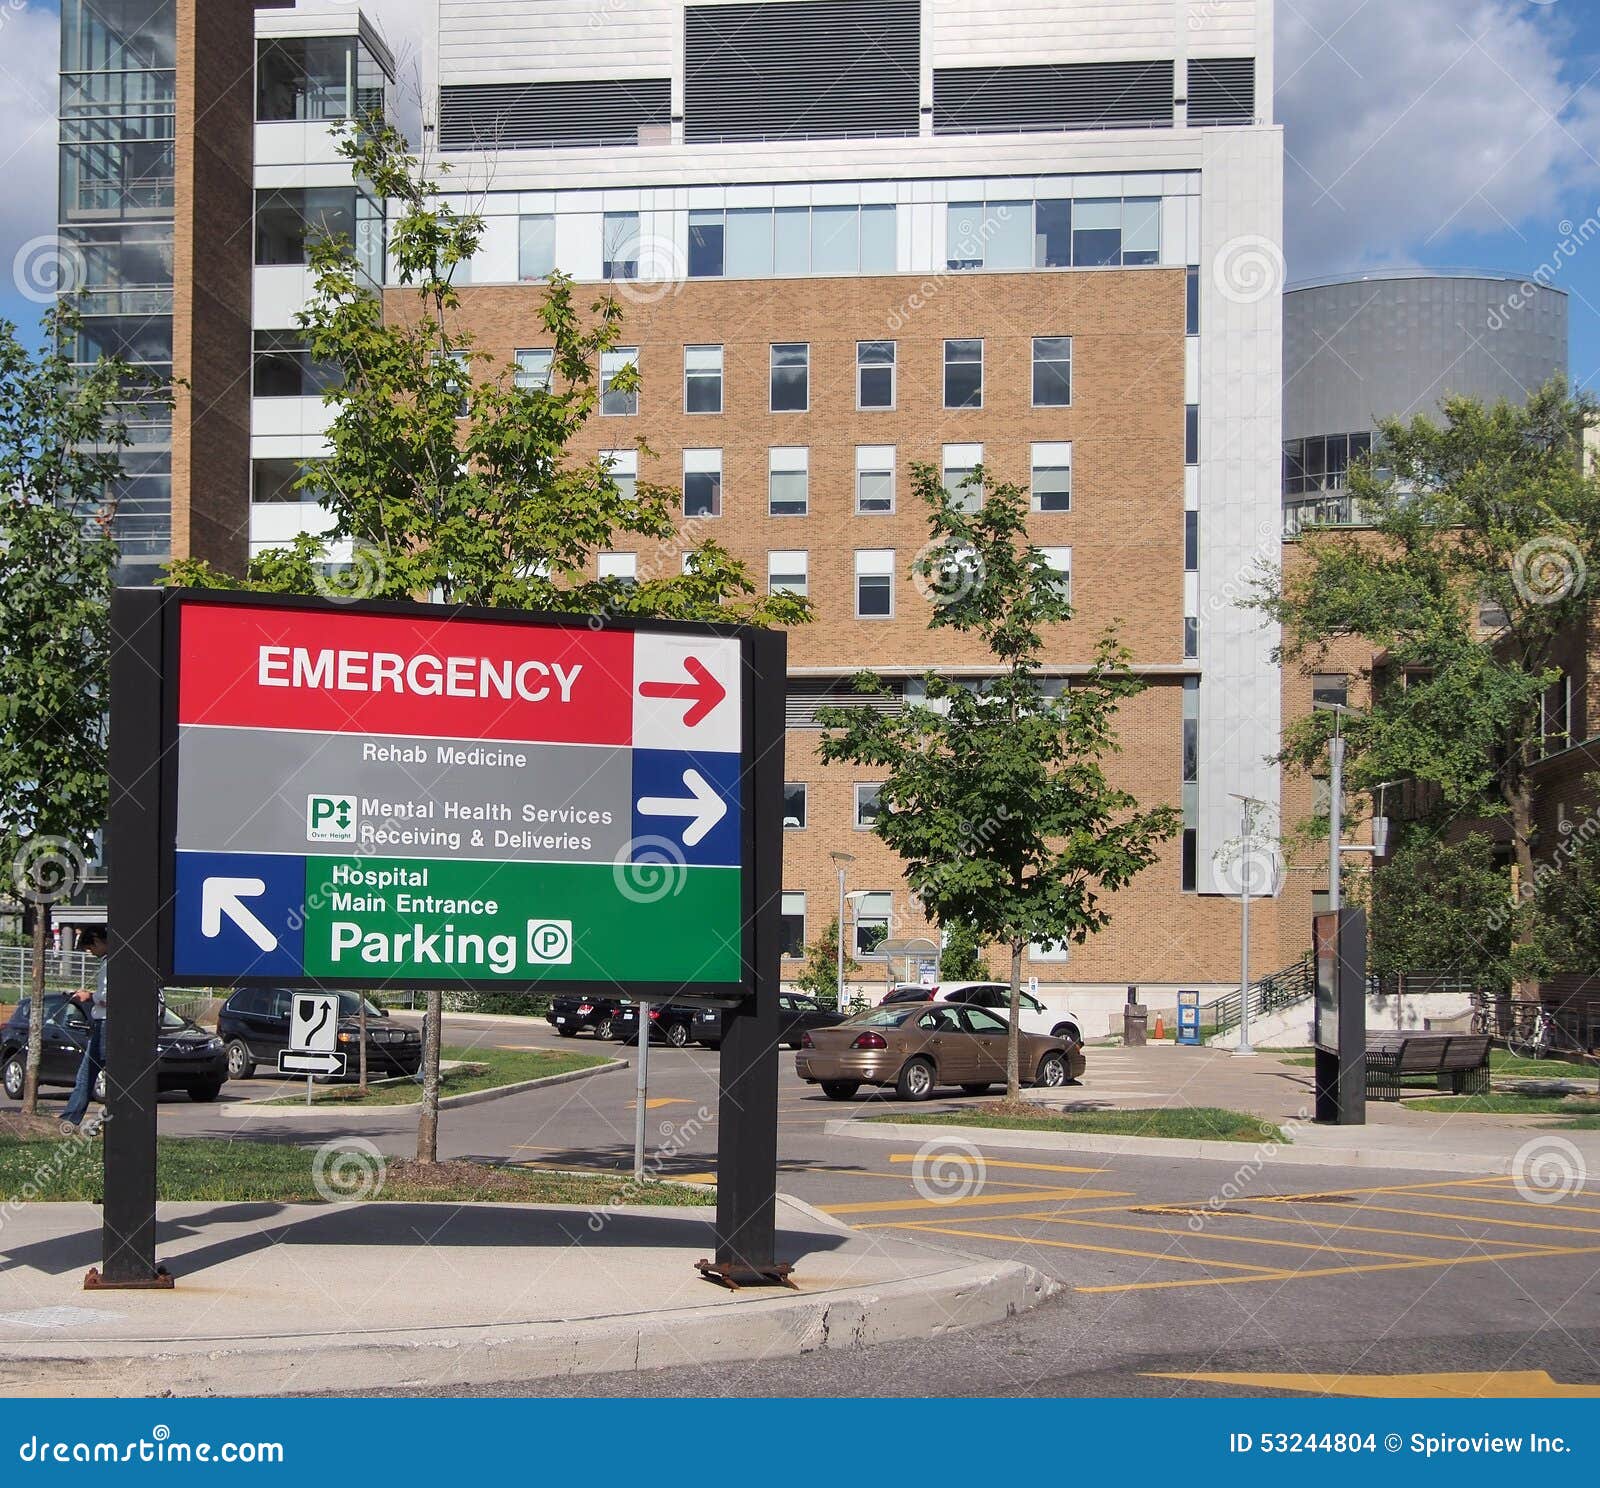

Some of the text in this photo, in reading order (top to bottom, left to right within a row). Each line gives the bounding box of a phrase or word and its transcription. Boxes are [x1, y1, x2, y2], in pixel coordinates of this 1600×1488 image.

[258, 645, 583, 703] EMERGENCY
[362, 743, 528, 769] Rehab Medicine
[361, 798, 612, 825] Mental Health Services
[361, 825, 592, 850] Receiving & Deliveries
[332, 865, 428, 889] Hospital
[332, 892, 498, 914] Main Entrance
[331, 921, 517, 974] Parking
